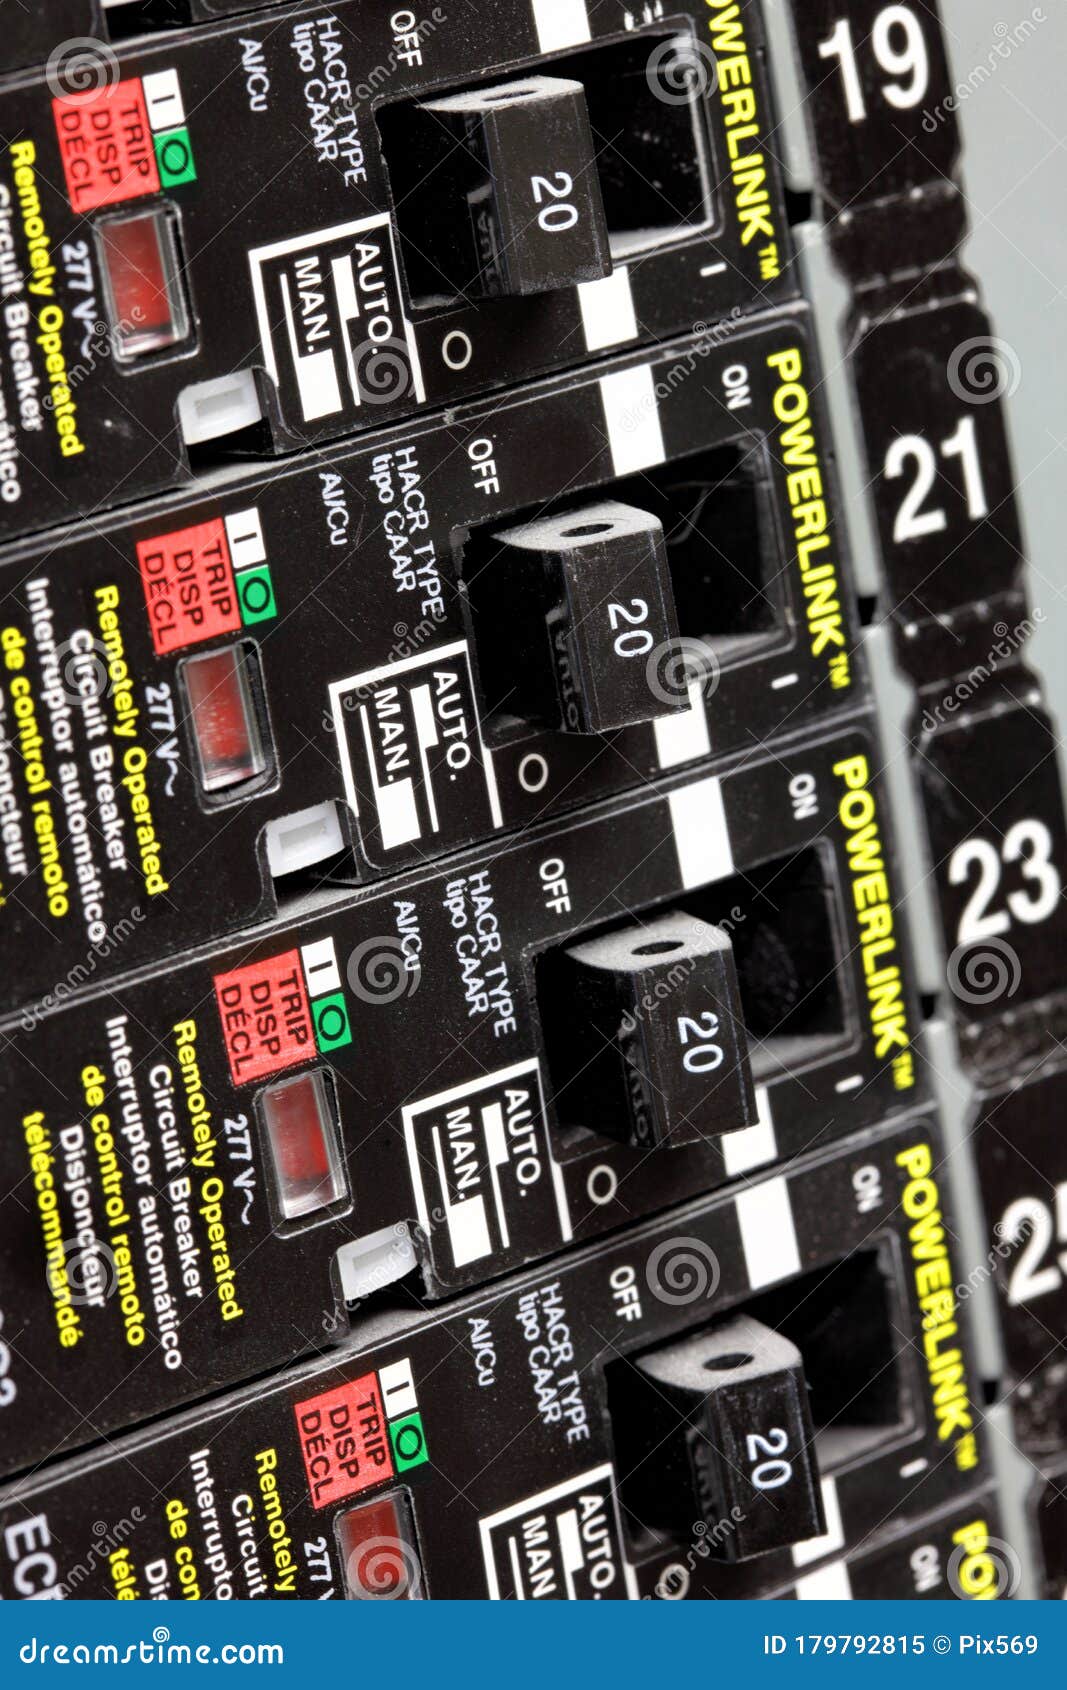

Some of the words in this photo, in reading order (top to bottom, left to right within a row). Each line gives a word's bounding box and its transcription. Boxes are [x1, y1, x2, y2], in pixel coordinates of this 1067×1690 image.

[390, 10, 423, 67] OFF
[818, 5, 929, 123] 19
[120, 101, 150, 177] TRIP
[290, 21, 316, 73] tipo
[304, 79, 339, 163] CAAR
[316, 16, 351, 104] HACR
[334, 110, 368, 187] TYPE
[705, 0, 780, 281] WERLINK™
[90, 109, 121, 186] DISP
[531, 171, 579, 232] 20
[10, 140, 56, 296] Remotely
[37, 305, 85, 457] Operated
[62, 241, 94, 292] 277
[294, 255, 330, 353] MAN.
[355, 243, 393, 355] AUTO.
[5, 302, 43, 431] Breaker
[721, 364, 752, 410] ON
[468, 438, 500, 495] OFF
[884, 414, 989, 544] 21
[368, 453, 395, 504] tipo
[383, 510, 416, 593] CAAR
[395, 445, 430, 535] HACR
[413, 539, 445, 616] TYPE
[174, 551, 204, 626] DISP
[202, 539, 232, 617] TRIP
[608, 598, 654, 658] 20
[1, 627, 26, 670] de
[10, 676, 52, 794] control
[70, 629, 108, 740] Circuit
[89, 744, 128, 872] Breaker
[94, 584, 139, 738] Remotely
[122, 746, 169, 895] Operated
[144, 682, 176, 732] 277
[373, 686, 410, 782] MAN.
[433, 671, 471, 781] AUTO.
[25, 577, 74, 753] Interruptor
[58, 761, 107, 943] automático
[788, 773, 819, 820] ON
[31, 801, 69, 917] remoto
[539, 857, 571, 914] OFF
[949, 818, 1061, 946] 23
[443, 878, 468, 929] tipo
[456, 934, 489, 1017] CAAR
[468, 870, 502, 957] HACR
[485, 961, 517, 1038] TYPE
[221, 983, 254, 1076] DÉCL
[250, 980, 281, 1056] DISP
[278, 969, 308, 1046] TRIP
[677, 1011, 724, 1074] 20
[81, 1064, 106, 1107] de
[90, 1113, 130, 1227] control
[150, 1064, 186, 1172] Circuit
[169, 1177, 203, 1299] Breaker
[173, 1019, 217, 1167] Remotely
[199, 1177, 244, 1321] Operated
[223, 1113, 252, 1161] 277
[445, 1105, 480, 1200] MAN.
[504, 1089, 542, 1197] AUTO.
[22, 1111, 84, 1348] télécommandé
[59, 1124, 105, 1308] Disjoncteur
[105, 1015, 153, 1187] Interruptor
[138, 1195, 182, 1370] automático
[851, 1164, 883, 1214] ON
[111, 1233, 146, 1347] remoto
[609, 1265, 643, 1322] OFF
[1001, 1181, 1067, 1307] 2
[515, 1291, 541, 1342] tipo
[529, 1345, 563, 1424] CAAR
[540, 1282, 574, 1367] HACR
[557, 1370, 590, 1444] TYPE
[300, 1409, 334, 1501] DÉCL
[329, 1404, 360, 1479] DISP
[356, 1392, 387, 1467] TRIP
[745, 1427, 793, 1490] 20
[165, 1499, 189, 1540] de
[231, 1494, 268, 1598] Circuit
[254, 1448, 298, 1592] Remotely
[304, 1536, 332, 1582] 277
[521, 1514, 557, 1598] MAN
[578, 1495, 616, 1600] AUTO.
[910, 1544, 943, 1593] ON
